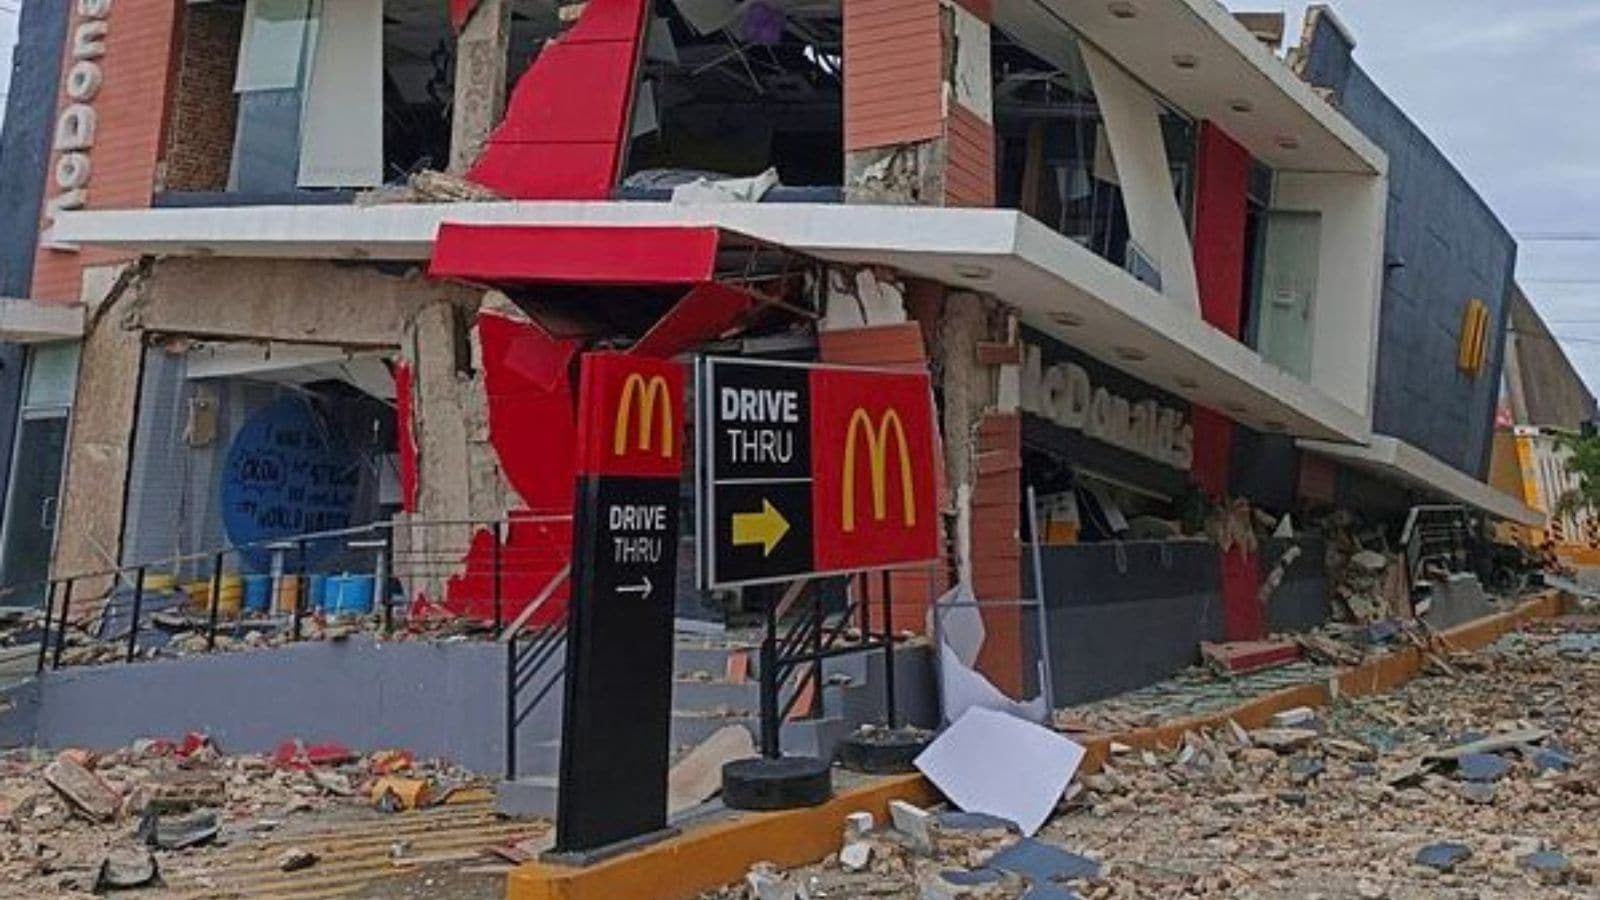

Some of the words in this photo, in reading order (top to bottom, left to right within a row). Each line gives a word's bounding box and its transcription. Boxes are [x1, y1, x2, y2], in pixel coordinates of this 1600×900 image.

[721, 387, 799, 423] DRIVE
[727, 429, 793, 463] THRU
[609, 505, 667, 530] DRIVE
[614, 536, 662, 563] THRU
